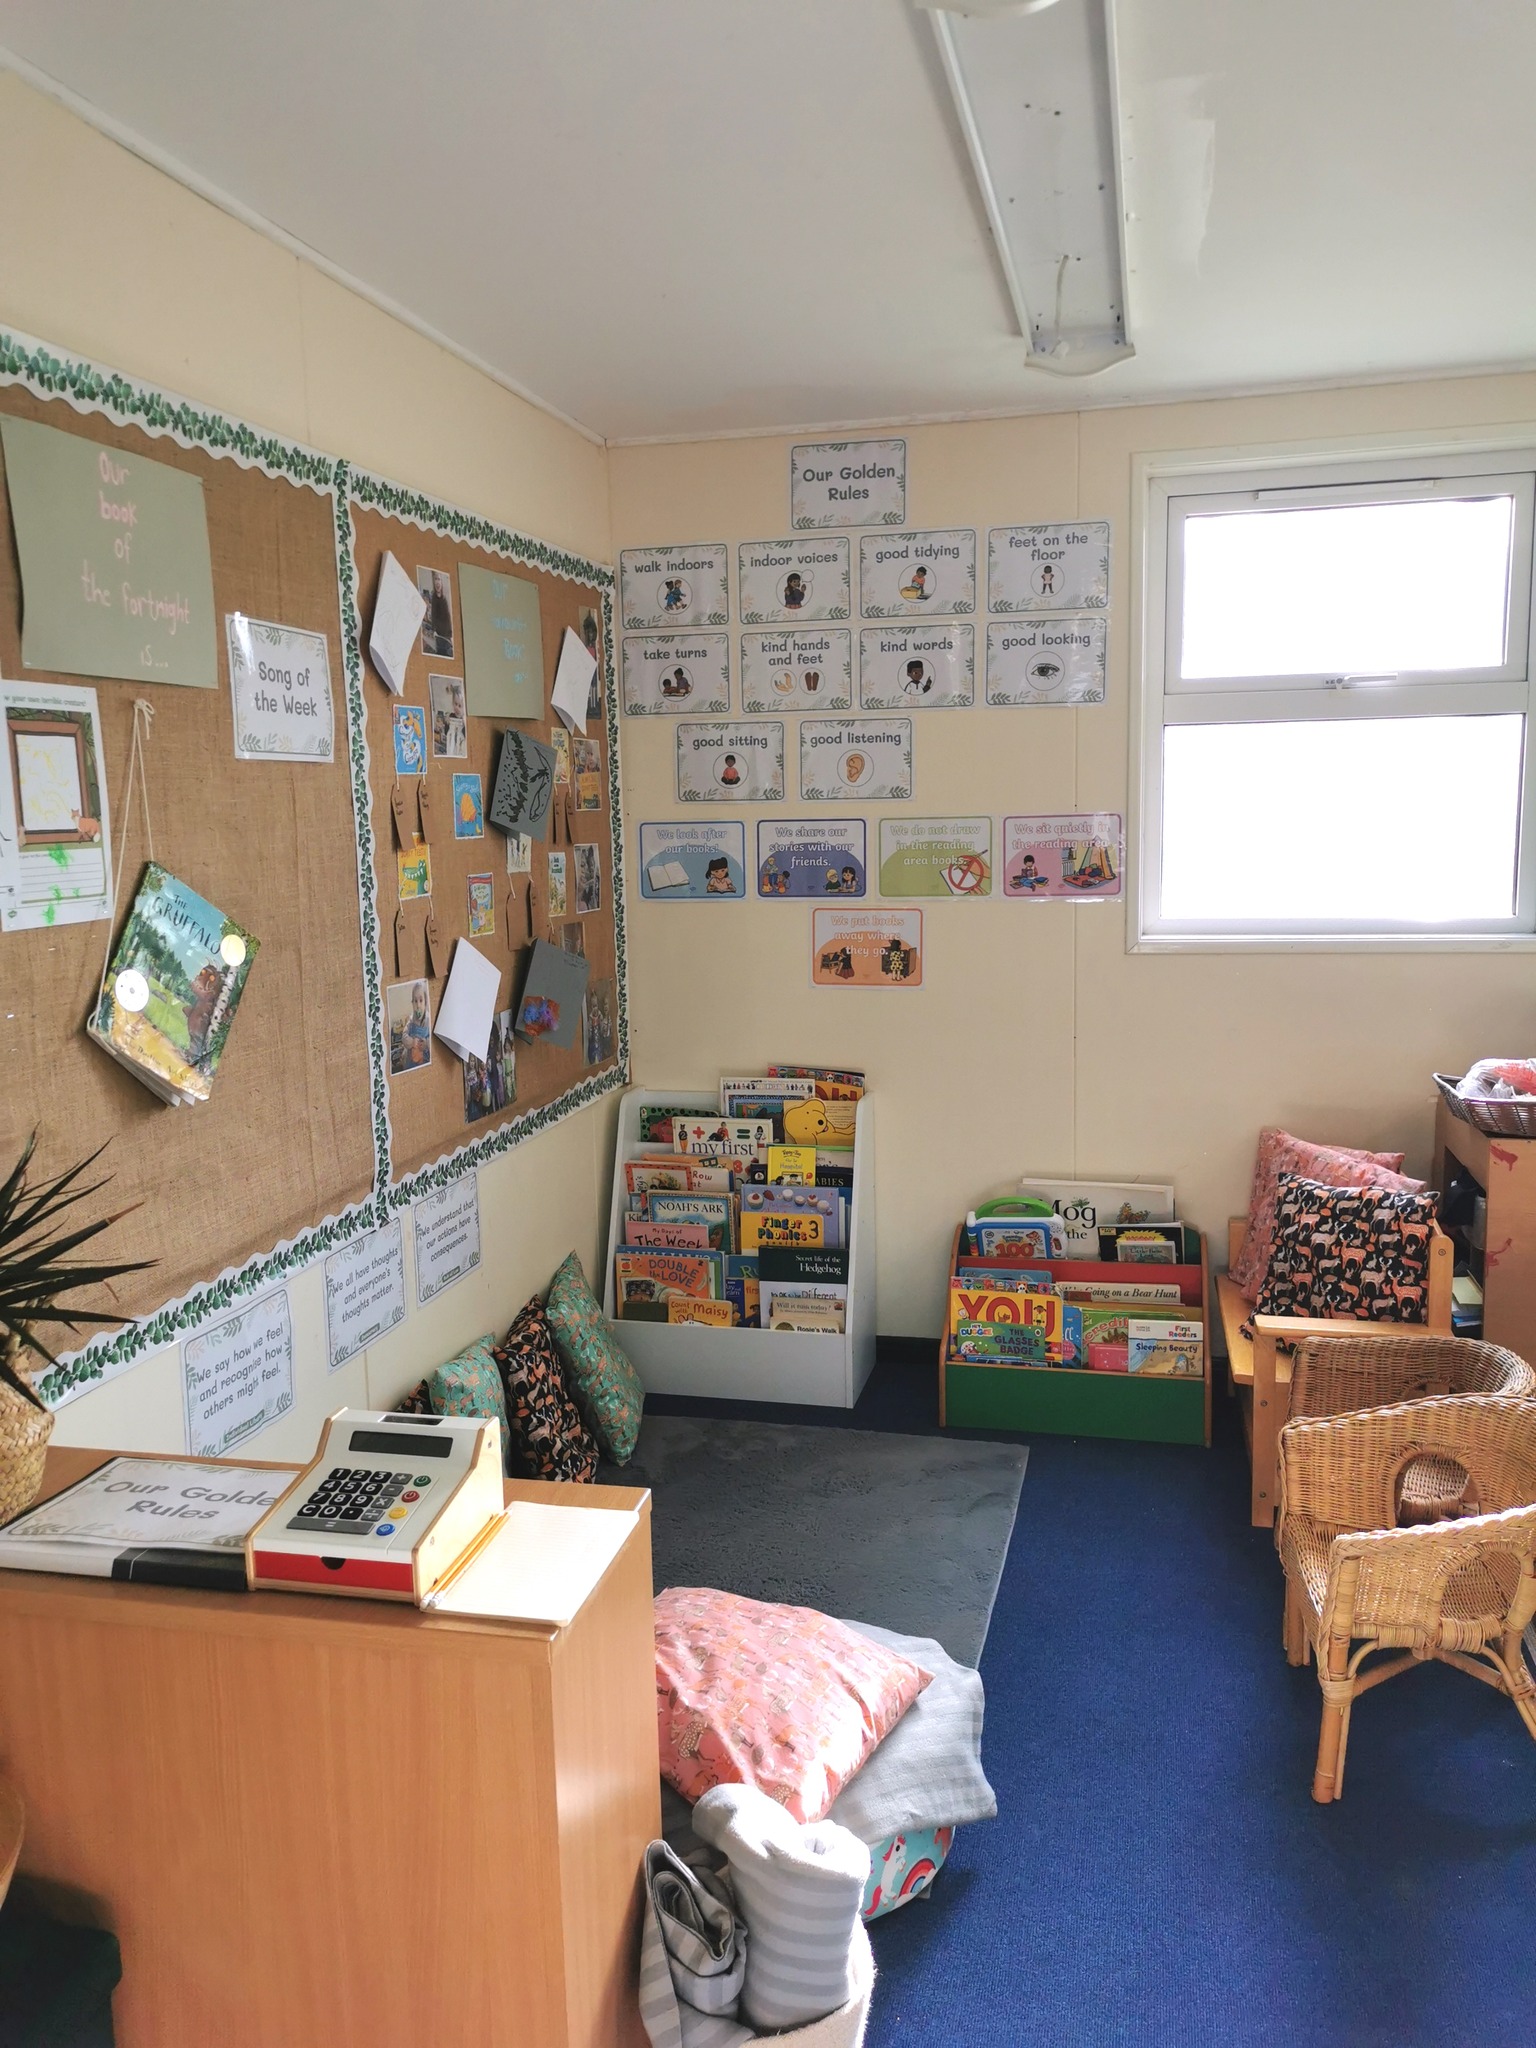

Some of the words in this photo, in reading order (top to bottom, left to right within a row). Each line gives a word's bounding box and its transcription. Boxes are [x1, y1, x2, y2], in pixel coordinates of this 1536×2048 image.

[99, 452, 131, 487] Our
[802, 466, 834, 483] Our
[839, 464, 895, 481] Golden
[828, 485, 870, 501] Rules
[99, 492, 138, 525] book
[1008, 534, 1037, 548] feet
[1042, 536, 1060, 547] on
[1064, 532, 1089, 545] the
[114, 533, 132, 564] of
[875, 547, 909, 564] good
[913, 544, 960, 562] tidying
[1030, 548, 1065, 561] floor
[634, 560, 663, 573] walk
[667, 557, 714, 572] indoors
[750, 553, 793, 568] indoor
[798, 551, 838, 565] voices
[81, 559, 112, 607] the
[122, 581, 191, 636] fortnight
[761, 640, 788, 653] kind
[793, 638, 830, 652] hands
[880, 640, 909, 653] kind
[912, 637, 954, 652] words
[1002, 635, 1036, 650] good
[1041, 632, 1091, 648] looking
[643, 648, 671, 661] take
[675, 647, 708, 660] turns
[768, 653, 793, 666] and
[796, 652, 823, 665] feet
[258, 661, 292, 690] Song
[296, 667, 311, 688] of
[254, 692, 278, 713] the
[284, 693, 318, 718] Week
[692, 735, 725, 750] good
[728, 733, 768, 750] sitting
[810, 733, 843, 748] good
[847, 731, 902, 747] listening
[656, 829, 674, 840] We
[676, 828, 698, 839] look
[701, 828, 727, 843] after
[775, 826, 793, 838] We
[798, 826, 826, 838] share
[828, 828, 848, 837] our
[890, 825, 909, 836] We
[911, 824, 925, 835] do
[927, 825, 948, 835] not
[950, 823, 981, 835] draw
[1014, 823, 1033, 834] We
[1035, 822, 1051, 833] sit
[1053, 821, 1095, 836] quietly
[1098, 822, 1110, 832] in
[665, 845, 684, 854] our
[768, 841, 805, 852] stories
[807, 841, 833, 852] with
[835, 843, 855, 852] our
[896, 840, 908, 850] in
[911, 840, 929, 850] the
[931, 839, 975, 852] reading
[1012, 839, 1032, 850] the
[1033, 838, 1078, 852] reading
[790, 856, 832, 869] friends.
[903, 856, 929, 865] area
[931, 854, 967, 865] books.
[174, 894, 188, 910] THE
[152, 896, 221, 955] GRUFFALO
[830, 916, 848, 926] We
[850, 916, 870, 928] put
[872, 914, 904, 927] books
[834, 933, 864, 942] away
[867, 931, 901, 941] where
[846, 945, 869, 957] they
[872, 947, 889, 958] go.
[691, 1141, 719, 1155] my
[722, 1139, 754, 1156] first
[692, 1171, 713, 1181] Row
[431, 1204, 463, 1231] understand
[463, 1198, 475, 1212] that
[658, 1202, 699, 1213] NOAH'S
[701, 1204, 723, 1214] ARK
[761, 1216, 803, 1230] Finger
[808, 1220, 819, 1239] 3
[426, 1238, 436, 1250] our
[437, 1224, 458, 1243] actions
[458, 1216, 471, 1229] have
[634, 1234, 662, 1247] The
[758, 1227, 808, 1241] Phonics
[1066, 1229, 1088, 1240] the
[995, 1242, 1034, 1257] 100
[795, 1254, 813, 1262] Secret
[331, 1281, 344, 1298] We
[345, 1271, 354, 1287] all
[355, 1264, 370, 1280] have
[371, 1247, 399, 1270] thoughts
[649, 1259, 699, 1279] DOUBLE
[799, 1262, 842, 1275] Hedgehog
[344, 1285, 357, 1305] and
[358, 1266, 391, 1295] everyone's
[661, 1271, 694, 1288] LOVE
[1085, 1286, 1110, 1299] Going
[1132, 1288, 1152, 1298] Bear
[1154, 1289, 1178, 1299] Hunt
[342, 1297, 370, 1323] thoughts
[371, 1283, 394, 1301] matter.
[693, 1303, 729, 1320] Maisy
[797, 1325, 820, 1333] Rosie's
[1009, 1328, 1025, 1336] THE
[1168, 1330, 1197, 1338] Readers
[994, 1335, 1040, 1348] GLASSES
[1135, 1342, 1167, 1353] Sleeping
[1169, 1342, 1198, 1353] Beauty
[196, 1368, 211, 1384] We
[215, 1358, 230, 1374] say
[233, 1345, 252, 1363] how
[253, 1337, 264, 1351] we
[266, 1322, 284, 1342] feel
[1000, 1345, 1034, 1356] BADGE
[200, 1380, 218, 1402] and
[220, 1356, 262, 1390] recognise
[265, 1345, 283, 1362] how
[203, 1394, 234, 1420] others
[237, 1376, 260, 1399] might
[261, 1362, 281, 1382] feel.
[335, 1470, 344, 1478] 1
[353, 1470, 365, 1479] 2
[374, 1471, 385, 1480] 3
[103, 1481, 170, 1494] Our
[180, 1487, 278, 1507] Golde
[324, 1481, 335, 1489] 4
[344, 1482, 355, 1490] 5
[366, 1483, 376, 1492] 6
[313, 1492, 324, 1500] 7
[334, 1494, 345, 1503] 8
[356, 1495, 367, 1504] 9
[125, 1499, 220, 1519] Rules
[302, 1505, 316, 1514] C
